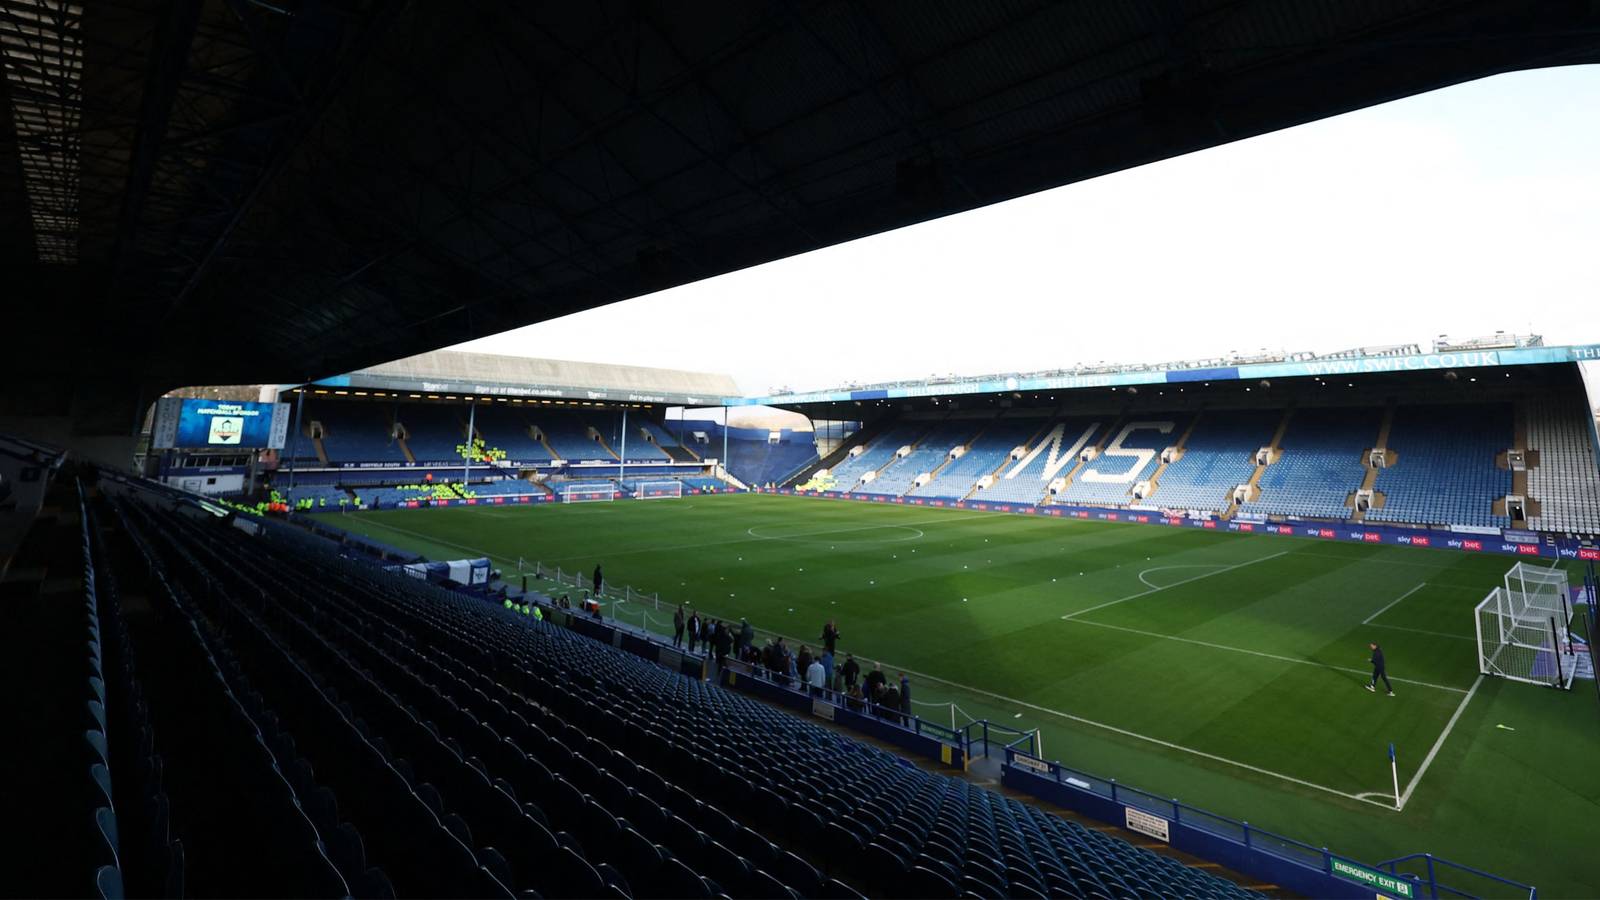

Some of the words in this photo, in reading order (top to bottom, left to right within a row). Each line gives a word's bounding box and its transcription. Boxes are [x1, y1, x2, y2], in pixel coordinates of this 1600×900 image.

[1306, 351, 1499, 375] WWW.SWFC.CO.UK
[1047, 375, 1111, 388] SHEFFIELD
[1266, 525, 1278, 533] sky
[1307, 528, 1319, 536] sky
[1320, 528, 1333, 537] bet
[1351, 531, 1363, 540] sky
[1365, 532, 1378, 540] bet
[1397, 535, 1411, 544] sky
[1412, 536, 1428, 544] bet
[1448, 539, 1462, 548] sky
[1464, 540, 1480, 549] bet
[1501, 543, 1517, 552] sky
[1520, 544, 1537, 553] bet
[1560, 548, 1577, 557] sky
[1580, 549, 1598, 558] bet
[1334, 862, 1377, 883] EMERGENCY
[1378, 877, 1396, 889] EXIT
